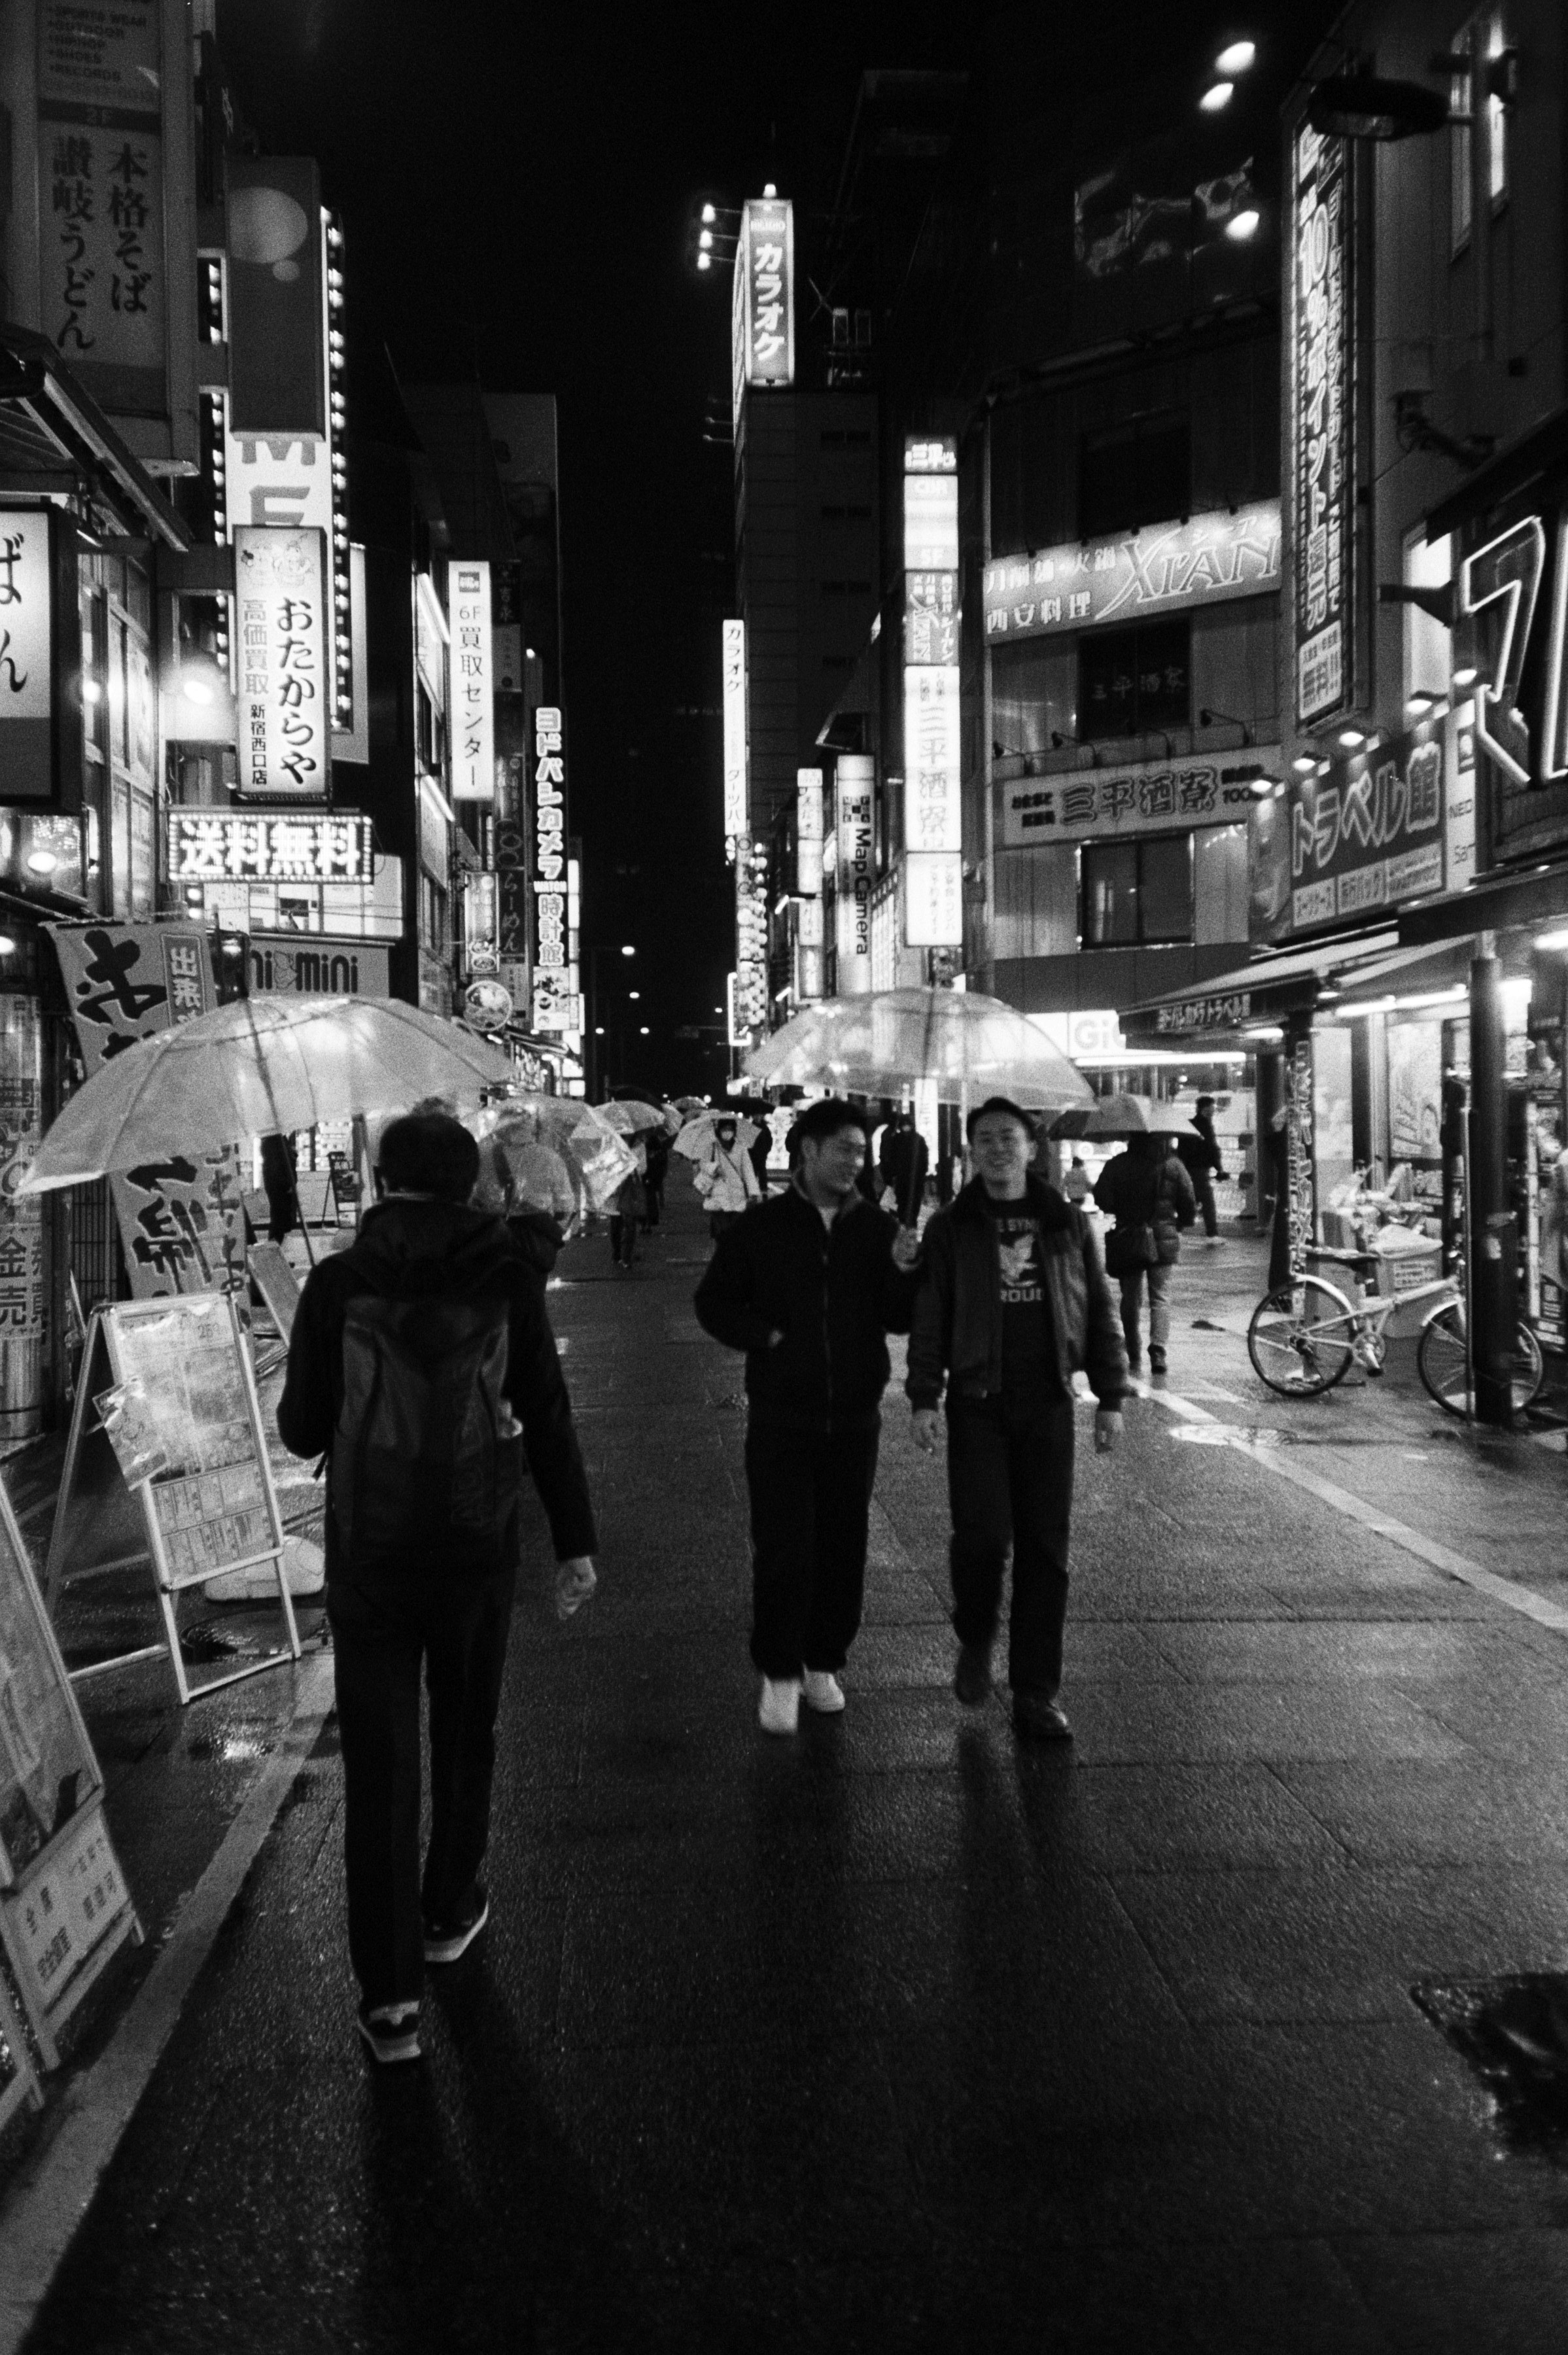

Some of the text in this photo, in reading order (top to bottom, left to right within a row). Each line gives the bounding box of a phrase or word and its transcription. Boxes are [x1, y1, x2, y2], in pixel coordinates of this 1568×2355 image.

[109, 142, 152, 313] 本格そば
[754, 242, 791, 362] カラオケ
[243, 599, 270, 695] 高価買取
[459, 606, 481, 620] 6F
[276, 597, 317, 784] おたからや
[727, 627, 741, 693] カラオケ
[251, 704, 268, 786] 新宿西口店
[460, 627, 483, 786] 買取センター
[535, 706, 564, 881] ヨドバシカメラ
[181, 821, 360, 876] 送料無料
[853, 829, 871, 955] Map Camera
[502, 872, 519, 951] らーめん
[538, 893, 565, 967] 時計館
[296, 952, 358, 994] mini
